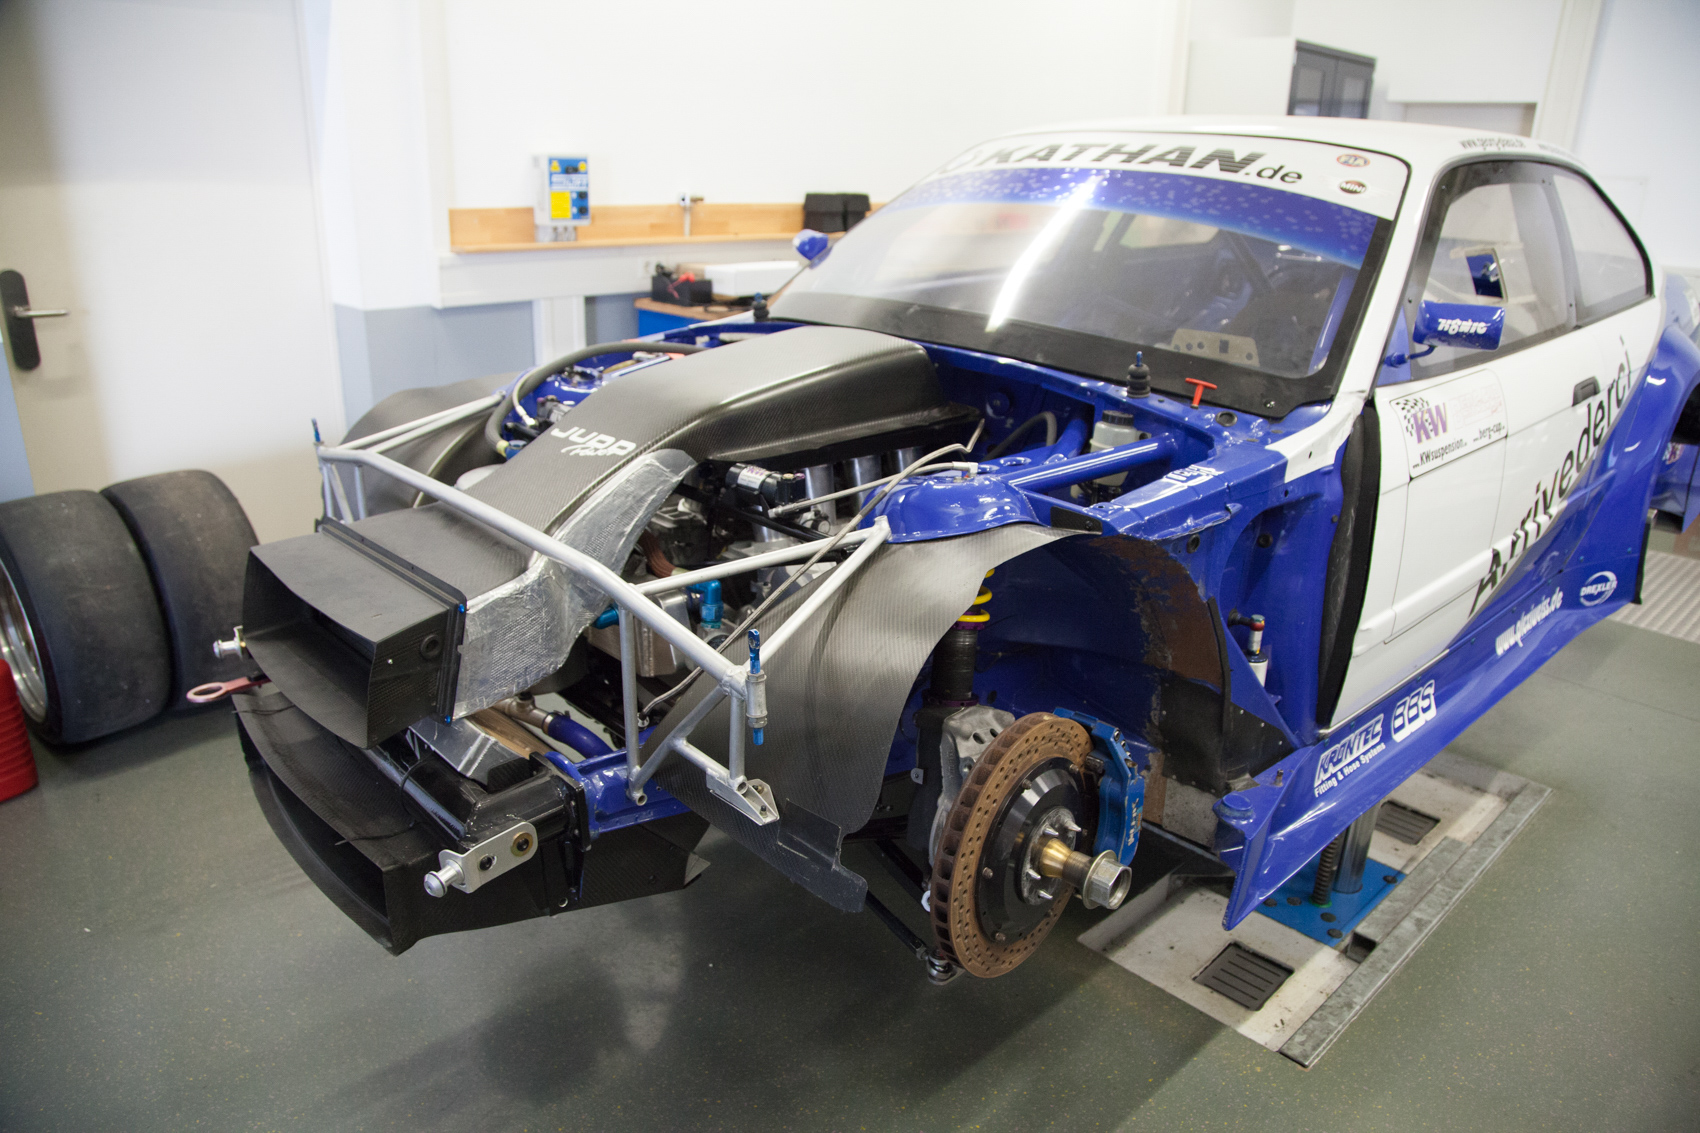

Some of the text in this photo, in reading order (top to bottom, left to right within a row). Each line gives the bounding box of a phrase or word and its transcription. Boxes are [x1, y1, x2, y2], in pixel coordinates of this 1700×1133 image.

[1340, 181, 1366, 193] MINI
[550, 426, 637, 456] JUDD
[1412, 402, 1448, 444] KW
[1468, 334, 1631, 618] Arrivederci
[1580, 580, 1618, 597] DREXLER
[1314, 713, 1384, 788] KRONTEC
[1314, 742, 1386, 798] Fitting & Hose Systems
